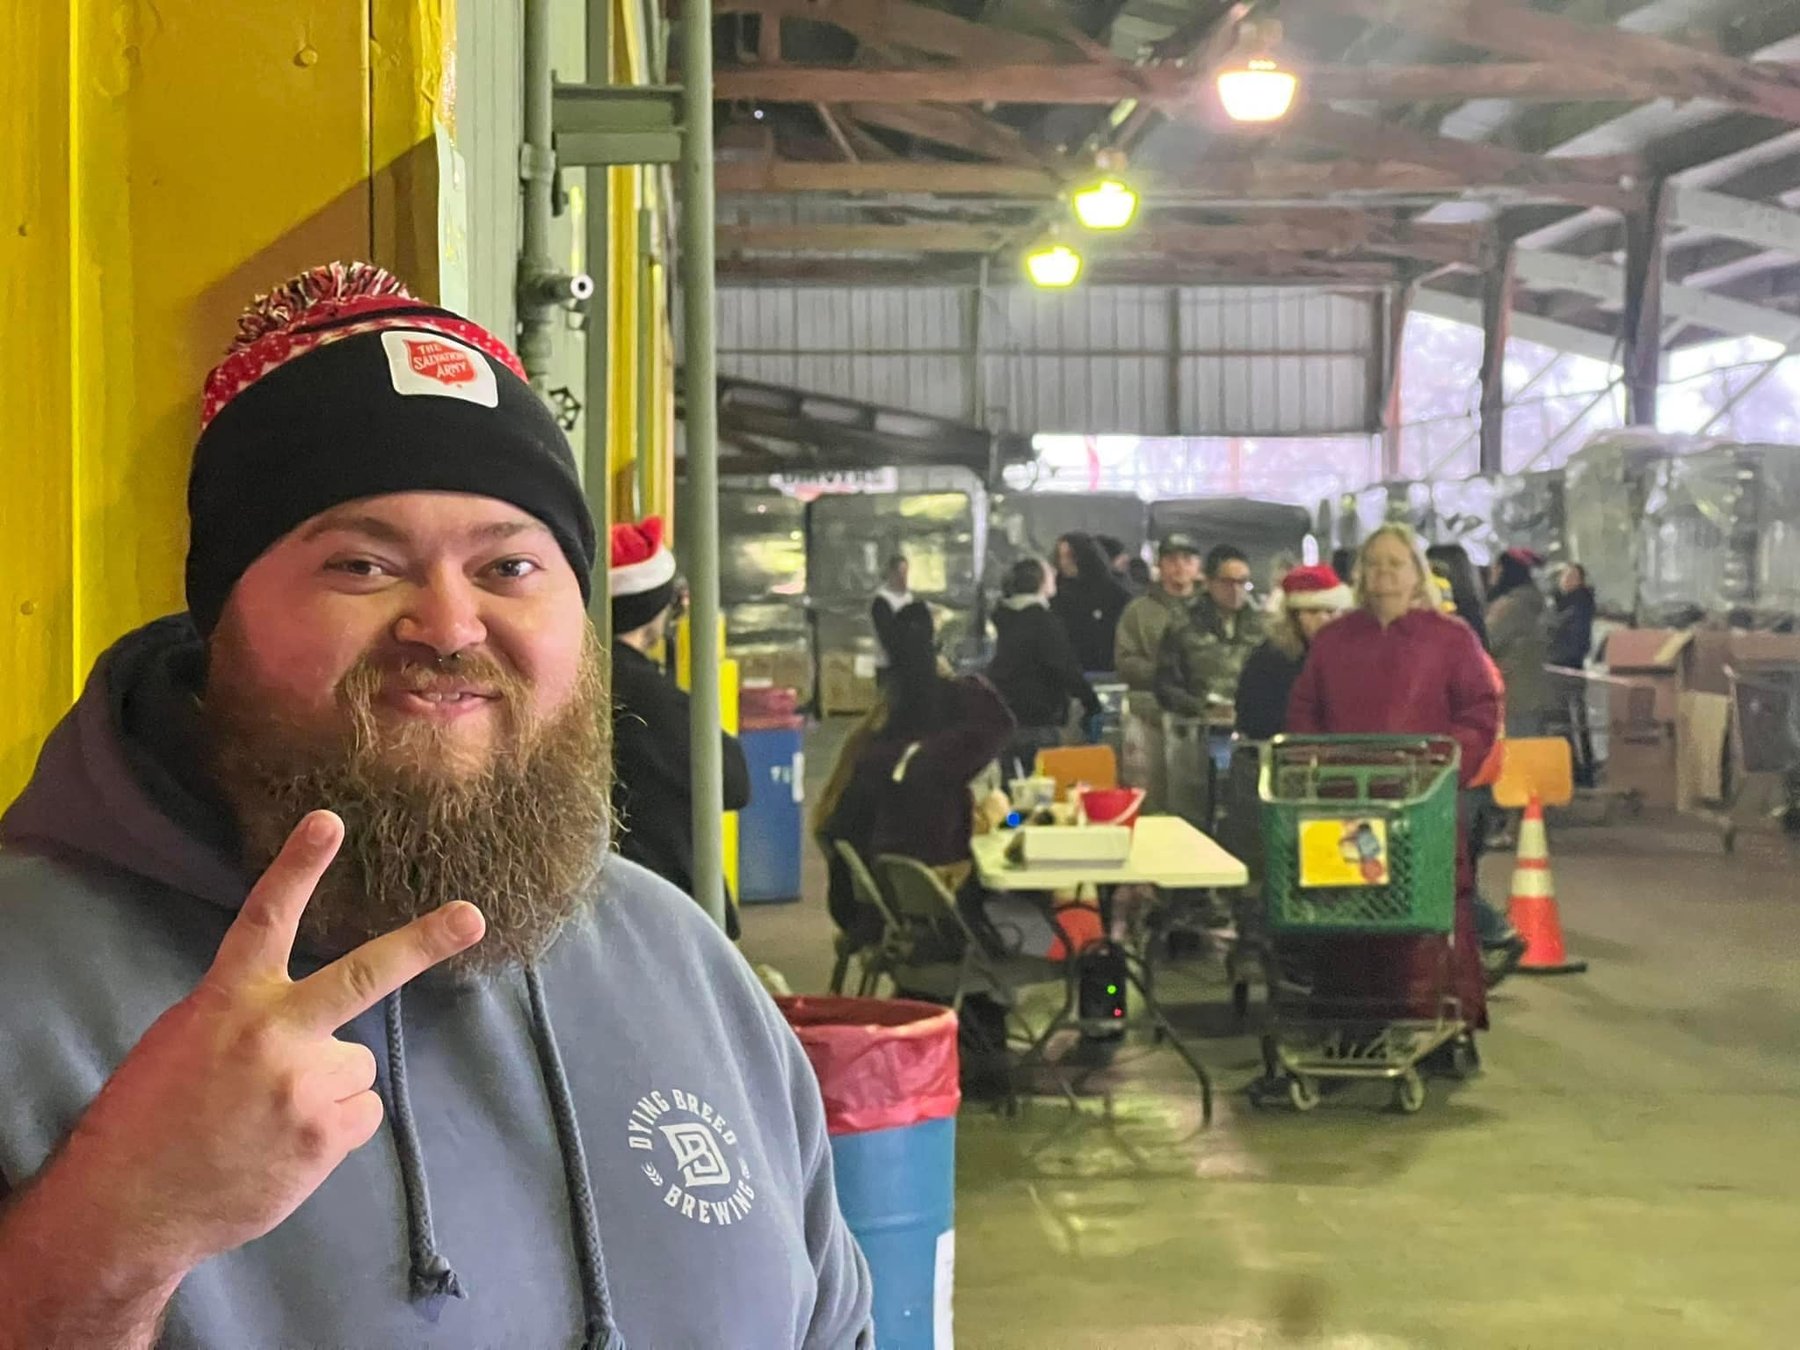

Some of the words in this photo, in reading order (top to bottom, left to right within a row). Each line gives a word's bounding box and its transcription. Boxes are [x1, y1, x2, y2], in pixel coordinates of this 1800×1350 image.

[416, 343, 442, 355] THE
[436, 361, 468, 378] ARMY
[628, 1090, 670, 1150] DYING
[672, 1089, 737, 1145] BREED
[663, 1179, 755, 1225] BREWING
